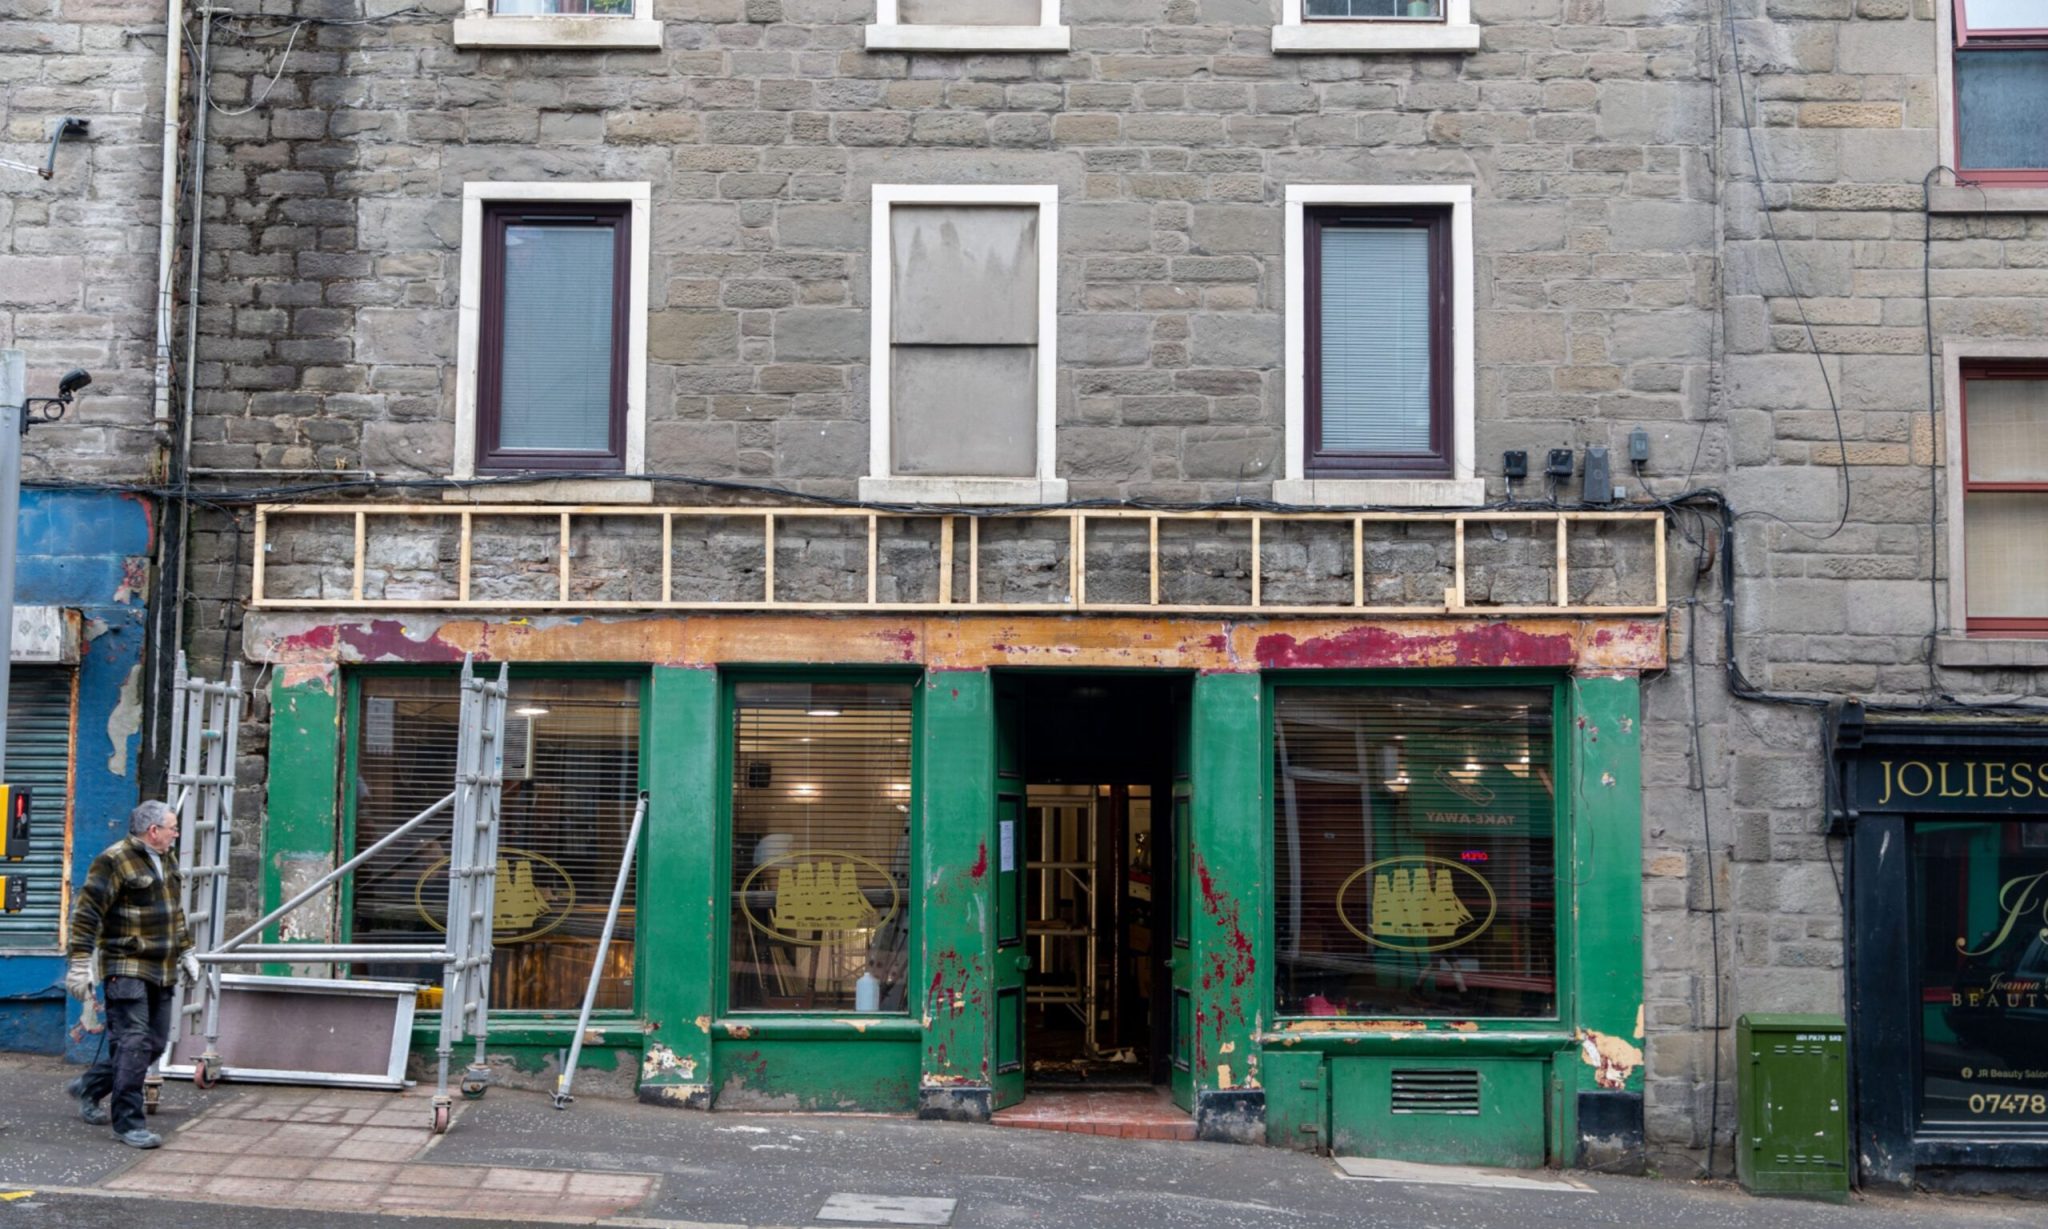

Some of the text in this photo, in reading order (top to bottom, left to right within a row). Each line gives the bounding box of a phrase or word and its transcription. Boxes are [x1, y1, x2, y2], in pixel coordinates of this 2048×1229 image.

[1956, 870, 2048, 956] J
[1980, 971, 2040, 994] Joanna
[1977, 1069, 1989, 1078] JR
[1990, 1069, 2022, 1080] Beauty
[1968, 1093, 2047, 1114] 07478
